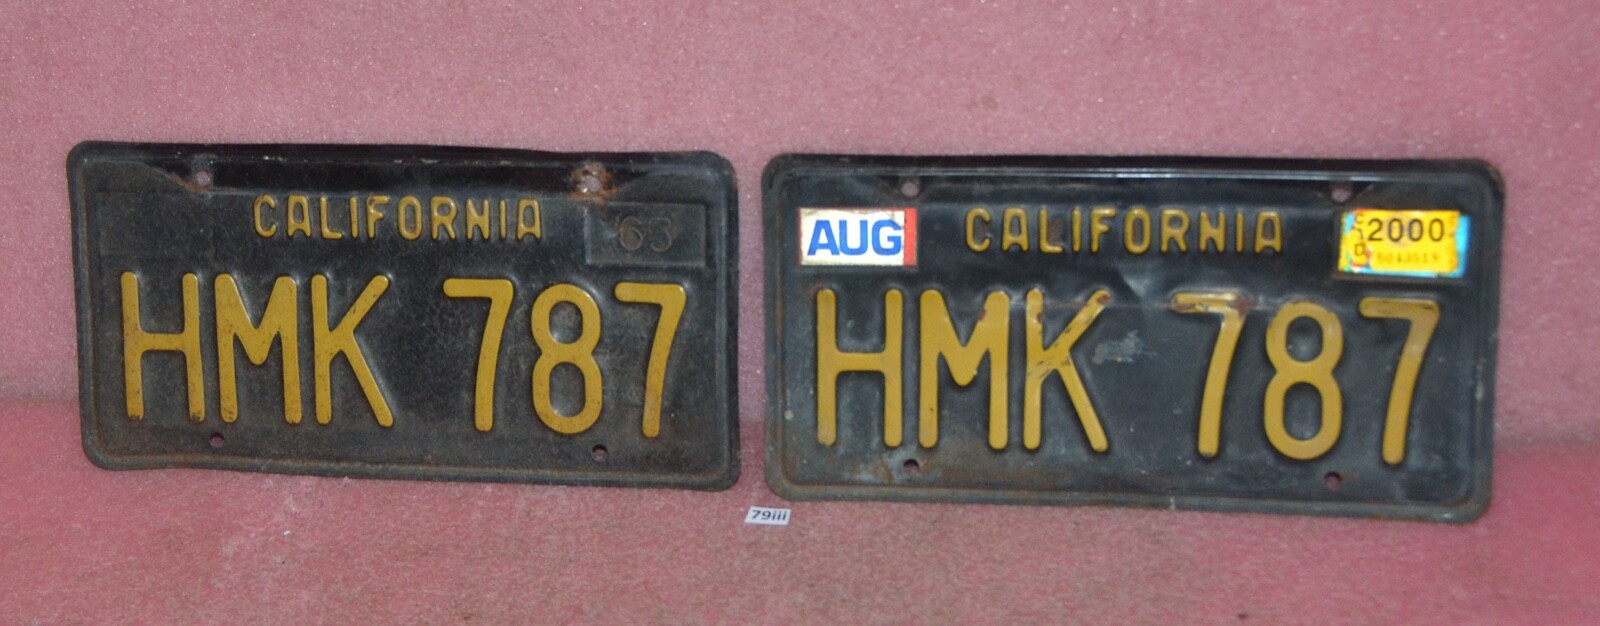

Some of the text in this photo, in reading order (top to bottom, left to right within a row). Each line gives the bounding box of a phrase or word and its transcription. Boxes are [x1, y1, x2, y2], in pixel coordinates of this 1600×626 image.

[253, 194, 543, 241] CALIFORNIA
[619, 215, 673, 253] 63
[807, 219, 903, 257] AUG
[965, 208, 1283, 254] CALIFORNIA
[1367, 218, 1445, 242] 2000
[120, 271, 687, 439] HMK 787
[816, 288, 1441, 465] HMK 787
[752, 509, 788, 521] 79iii
